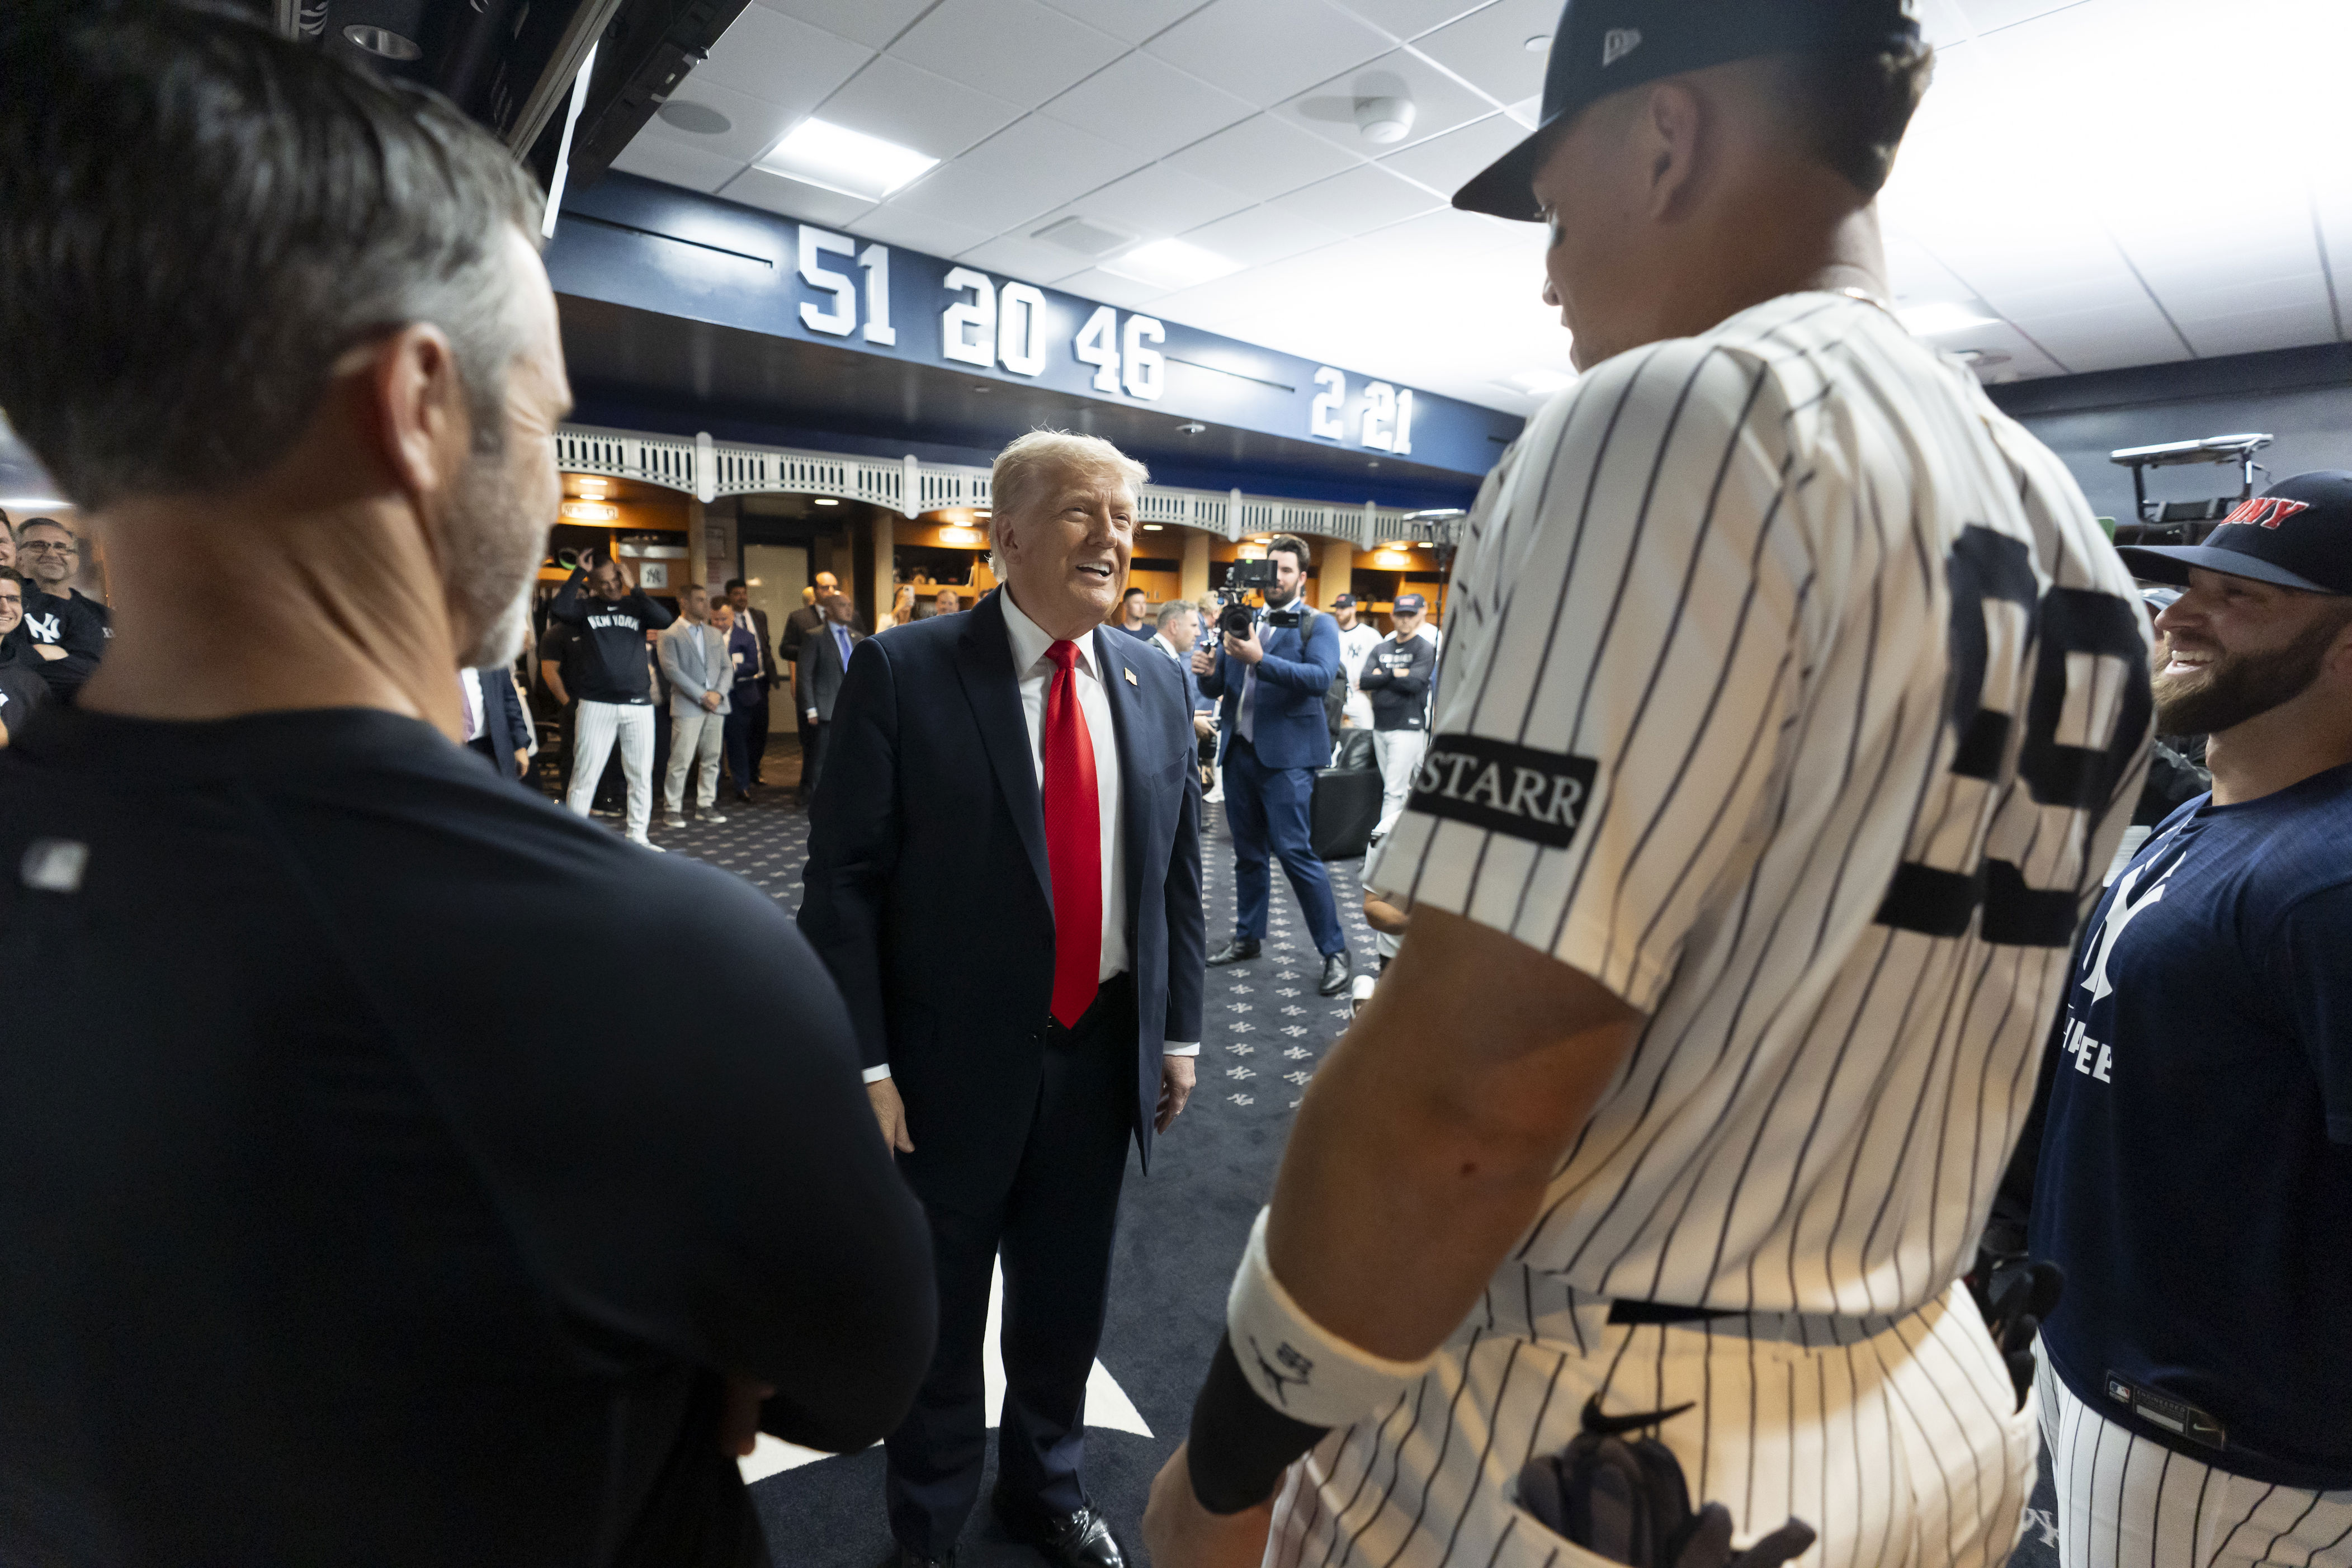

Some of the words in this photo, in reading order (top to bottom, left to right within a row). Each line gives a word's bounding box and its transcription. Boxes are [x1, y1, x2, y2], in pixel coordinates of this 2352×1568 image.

[799, 224, 895, 346] 51
[943, 266, 1046, 376] 20
[1075, 305, 1165, 400] 46
[1311, 365, 1346, 440] 2
[1362, 380, 1413, 455] 21
[24, 613, 61, 643] NY
[588, 615, 612, 630] NEW
[612, 615, 640, 631] YORK
[1416, 750, 1584, 828] STARR
